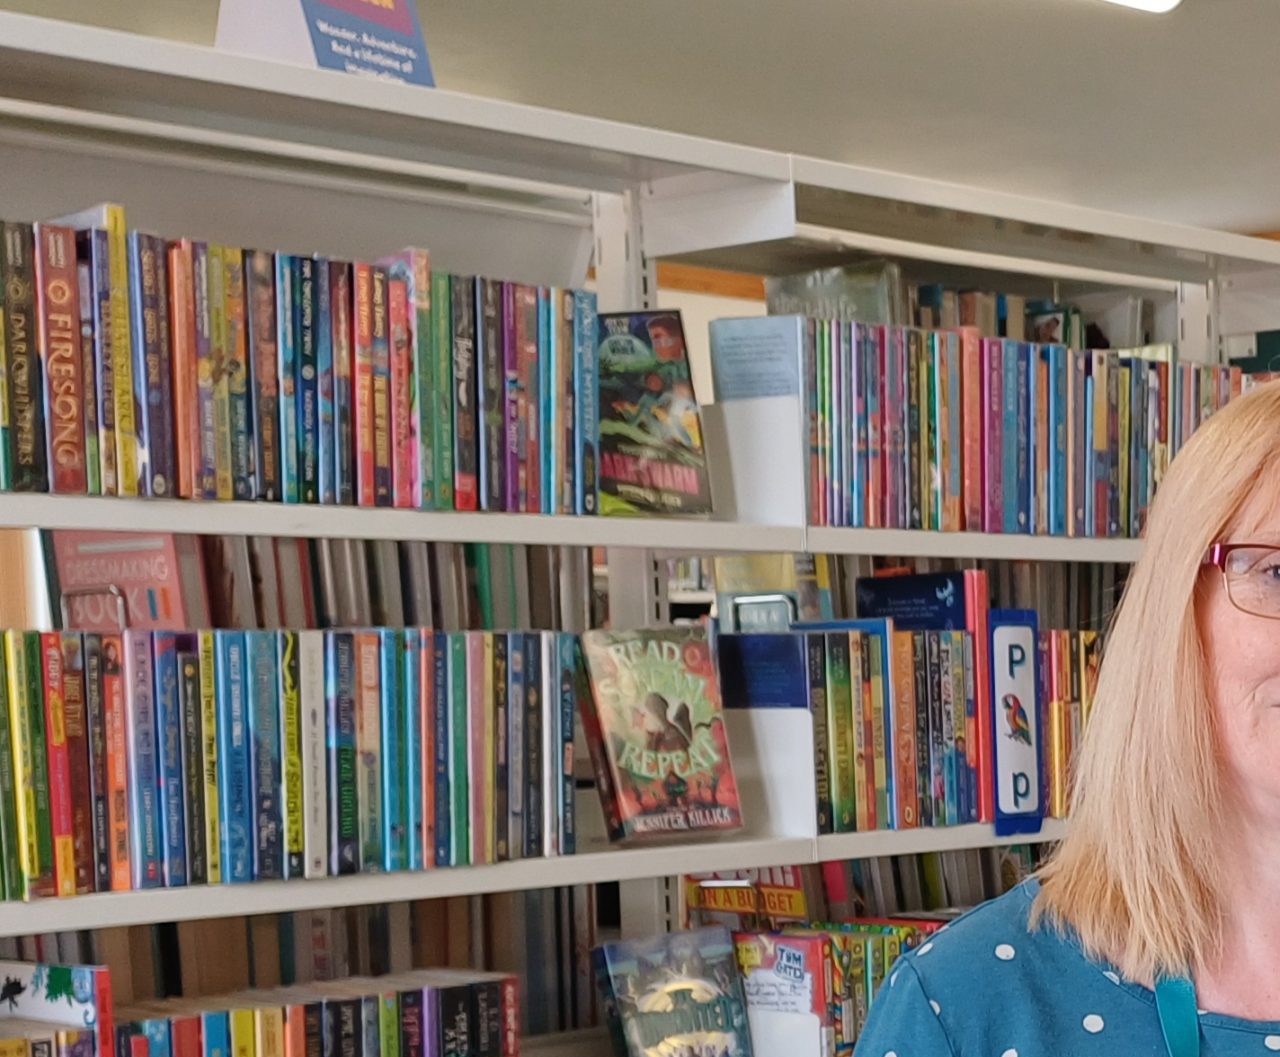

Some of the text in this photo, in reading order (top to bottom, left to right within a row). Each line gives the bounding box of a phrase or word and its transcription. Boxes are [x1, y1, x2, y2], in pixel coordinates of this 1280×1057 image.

[47, 312, 78, 466] FIRESONG
[1008, 643, 1026, 680] P
[617, 735, 721, 779] REPEAT
[634, 807, 731, 833] JENNIFER KILLICK
[722, 890, 734, 907] A
[738, 889, 795, 913] BUGET
[777, 947, 803, 966] TOM
